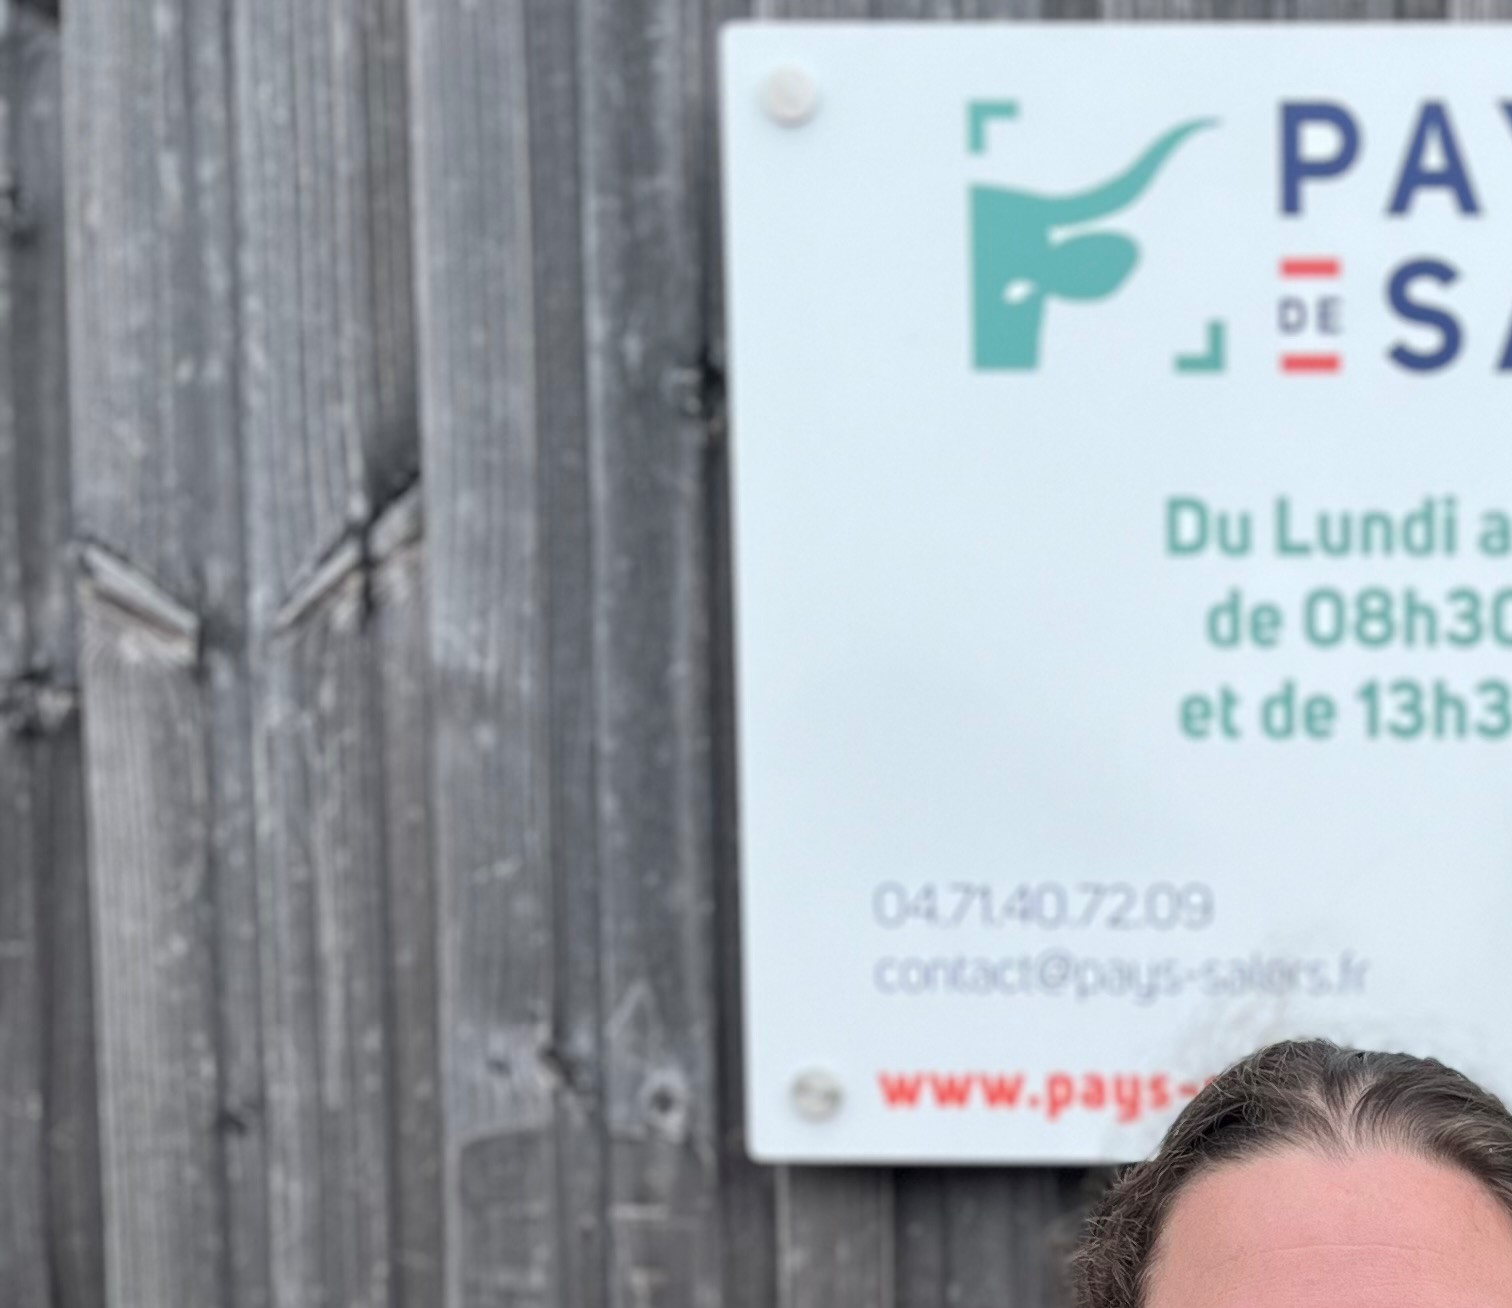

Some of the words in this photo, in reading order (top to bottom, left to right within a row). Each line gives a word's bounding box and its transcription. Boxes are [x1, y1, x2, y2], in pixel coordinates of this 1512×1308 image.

[1278, 297, 1342, 335] DE
[1164, 497, 1252, 557] Du
[1273, 497, 1460, 557] Lundi
[1205, 589, 1284, 649] de
[1178, 685, 1240, 740] et
[1260, 680, 1339, 740] de
[873, 948, 1372, 1003] contact@pays-salers.fr
